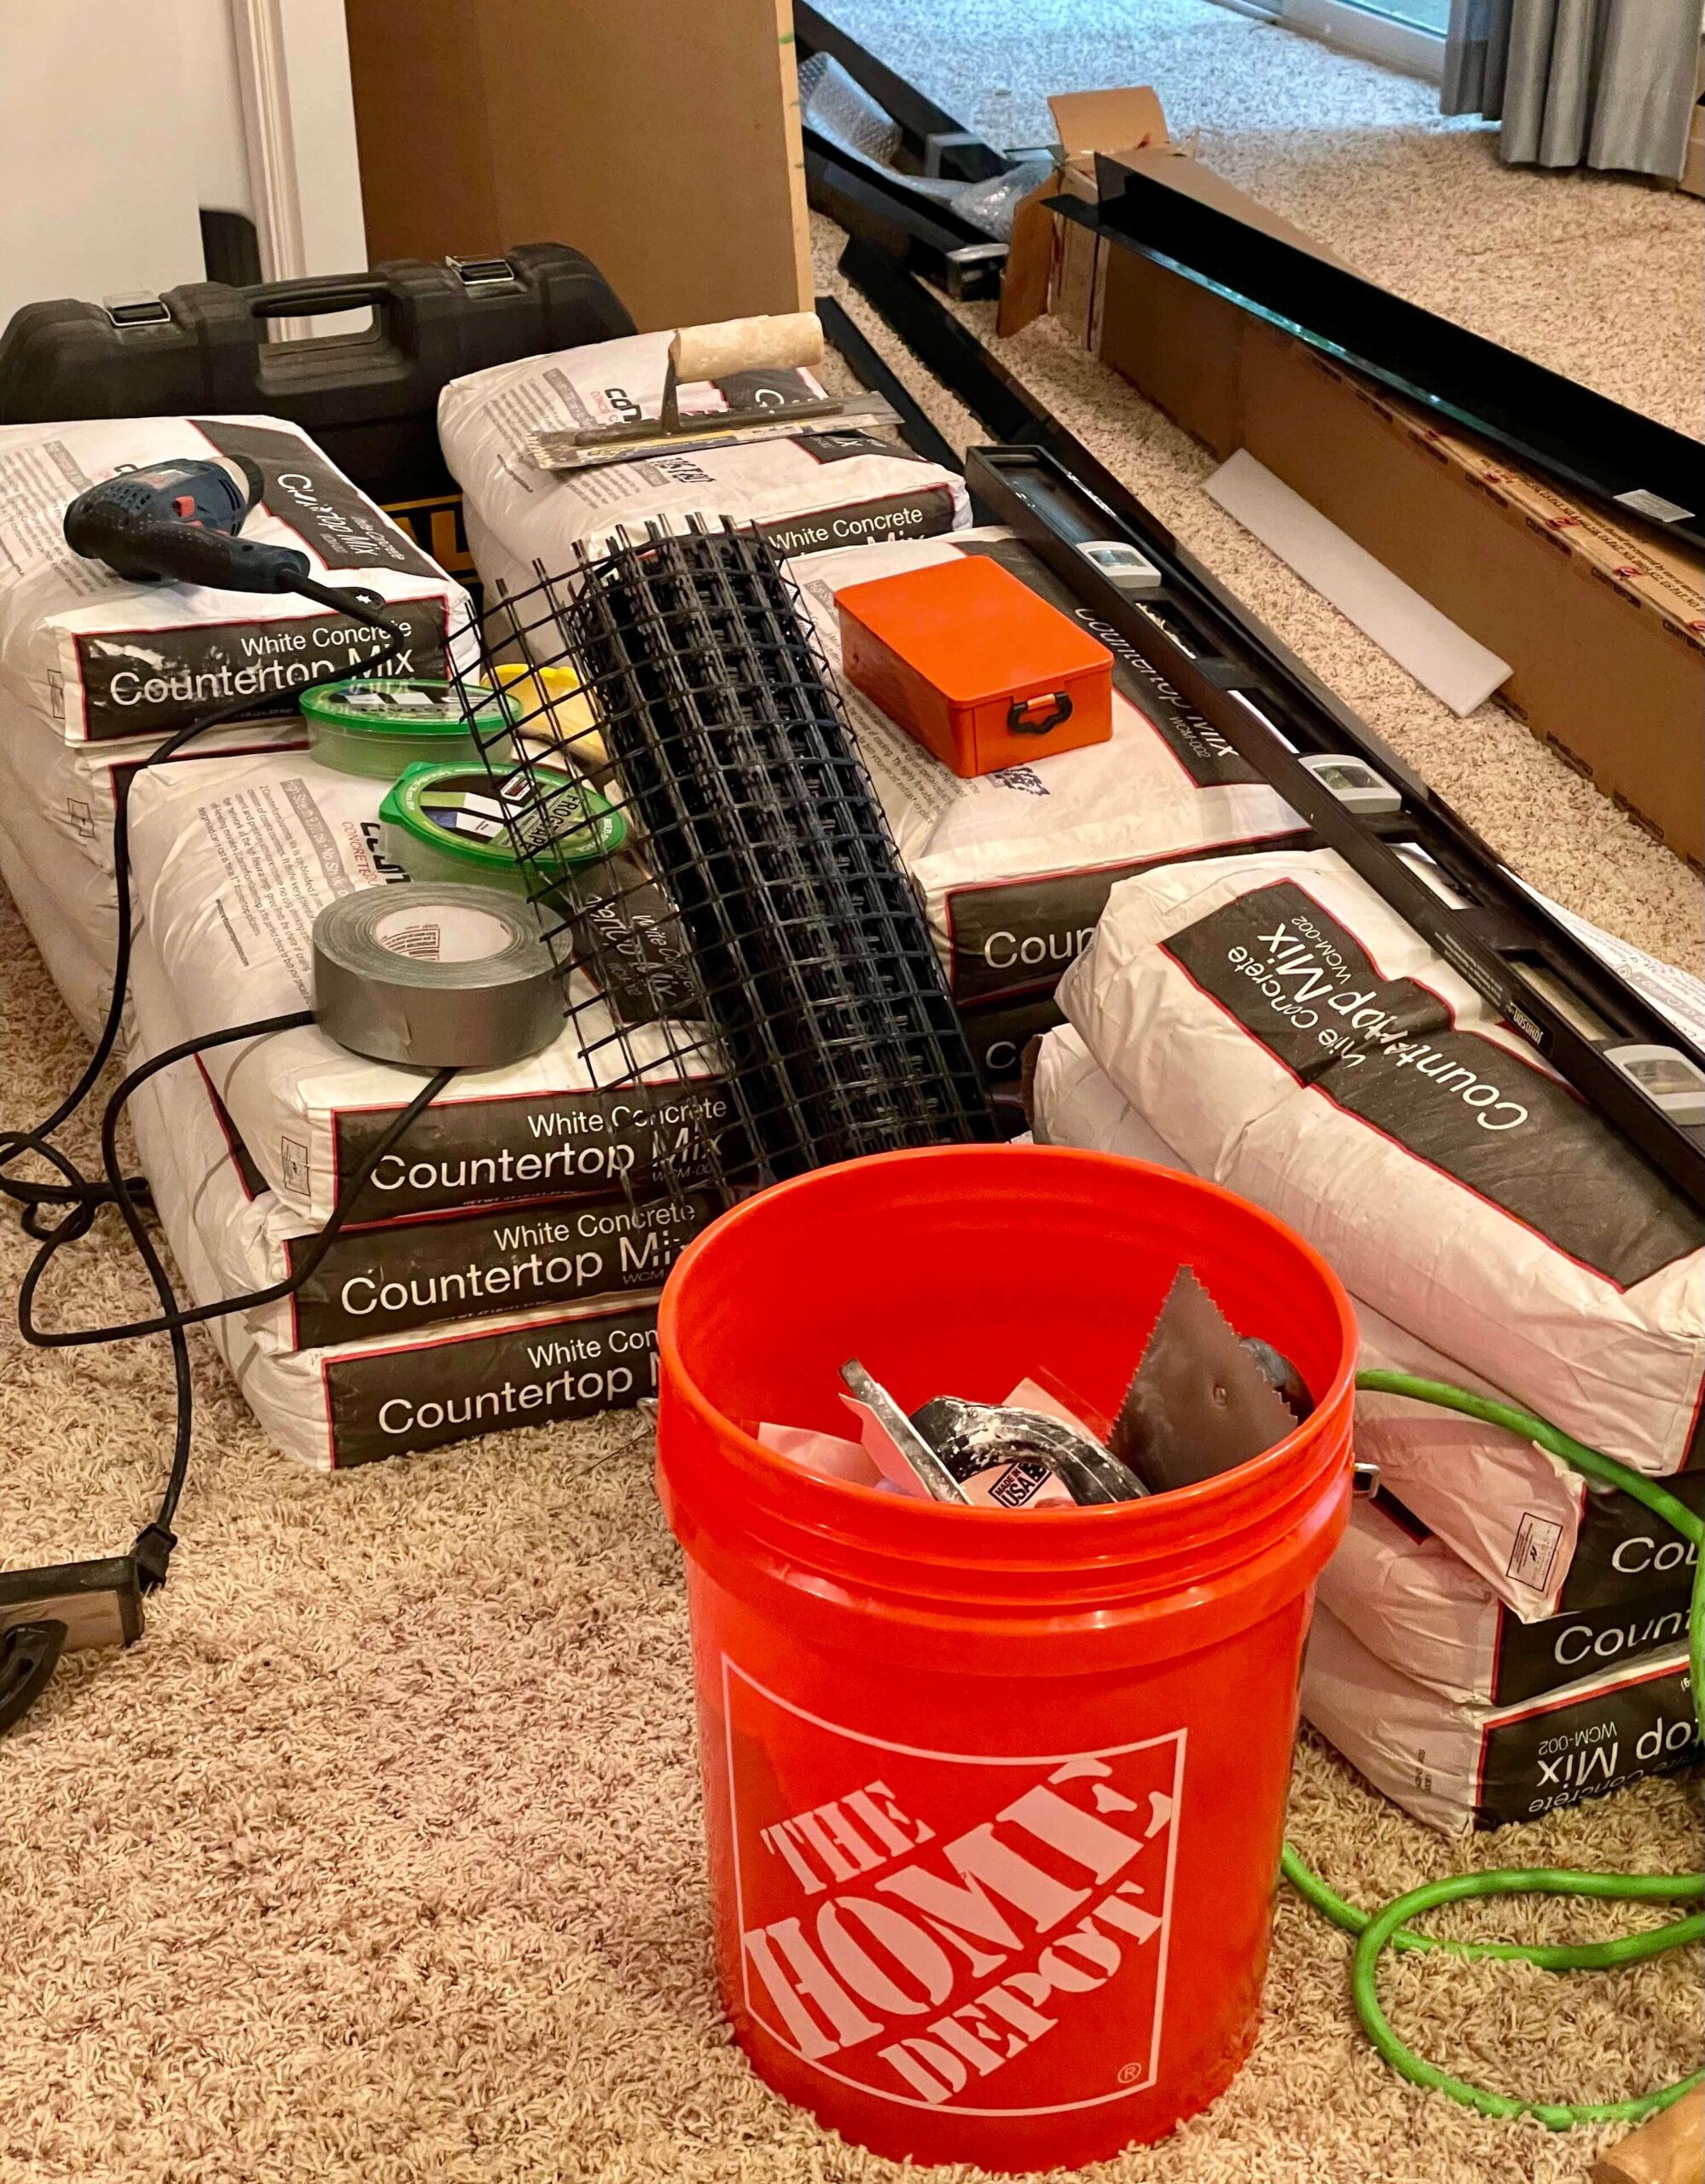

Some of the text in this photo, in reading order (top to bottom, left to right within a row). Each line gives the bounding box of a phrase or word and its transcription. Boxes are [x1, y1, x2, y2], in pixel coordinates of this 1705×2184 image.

[768, 507, 924, 550] White Concrete
[241, 619, 412, 658] White Concree
[1169, 715, 1211, 759] WCM-002
[1256, 922, 1334, 1003] Mix
[1291, 915, 1353, 985] WCM-002
[1227, 944, 1319, 1030] Concrete
[527, 1107, 604, 1138] White
[369, 1141, 635, 1191] Countertop
[493, 1201, 695, 1252] White Concrete
[340, 1251, 603, 1316] Countertop
[527, 1337, 602, 1369] White
[378, 1363, 634, 1435] Countertop
[995, 1467, 1022, 1496] MADE IN
[1000, 1477, 1036, 1507] USA
[1538, 1720, 1618, 1755] WCM-002
[1535, 1741, 1619, 1790] Mix
[760, 1780, 937, 1896] THE
[743, 1757, 1173, 2059] HOME
[876, 1879, 1163, 2105] DEPOT
